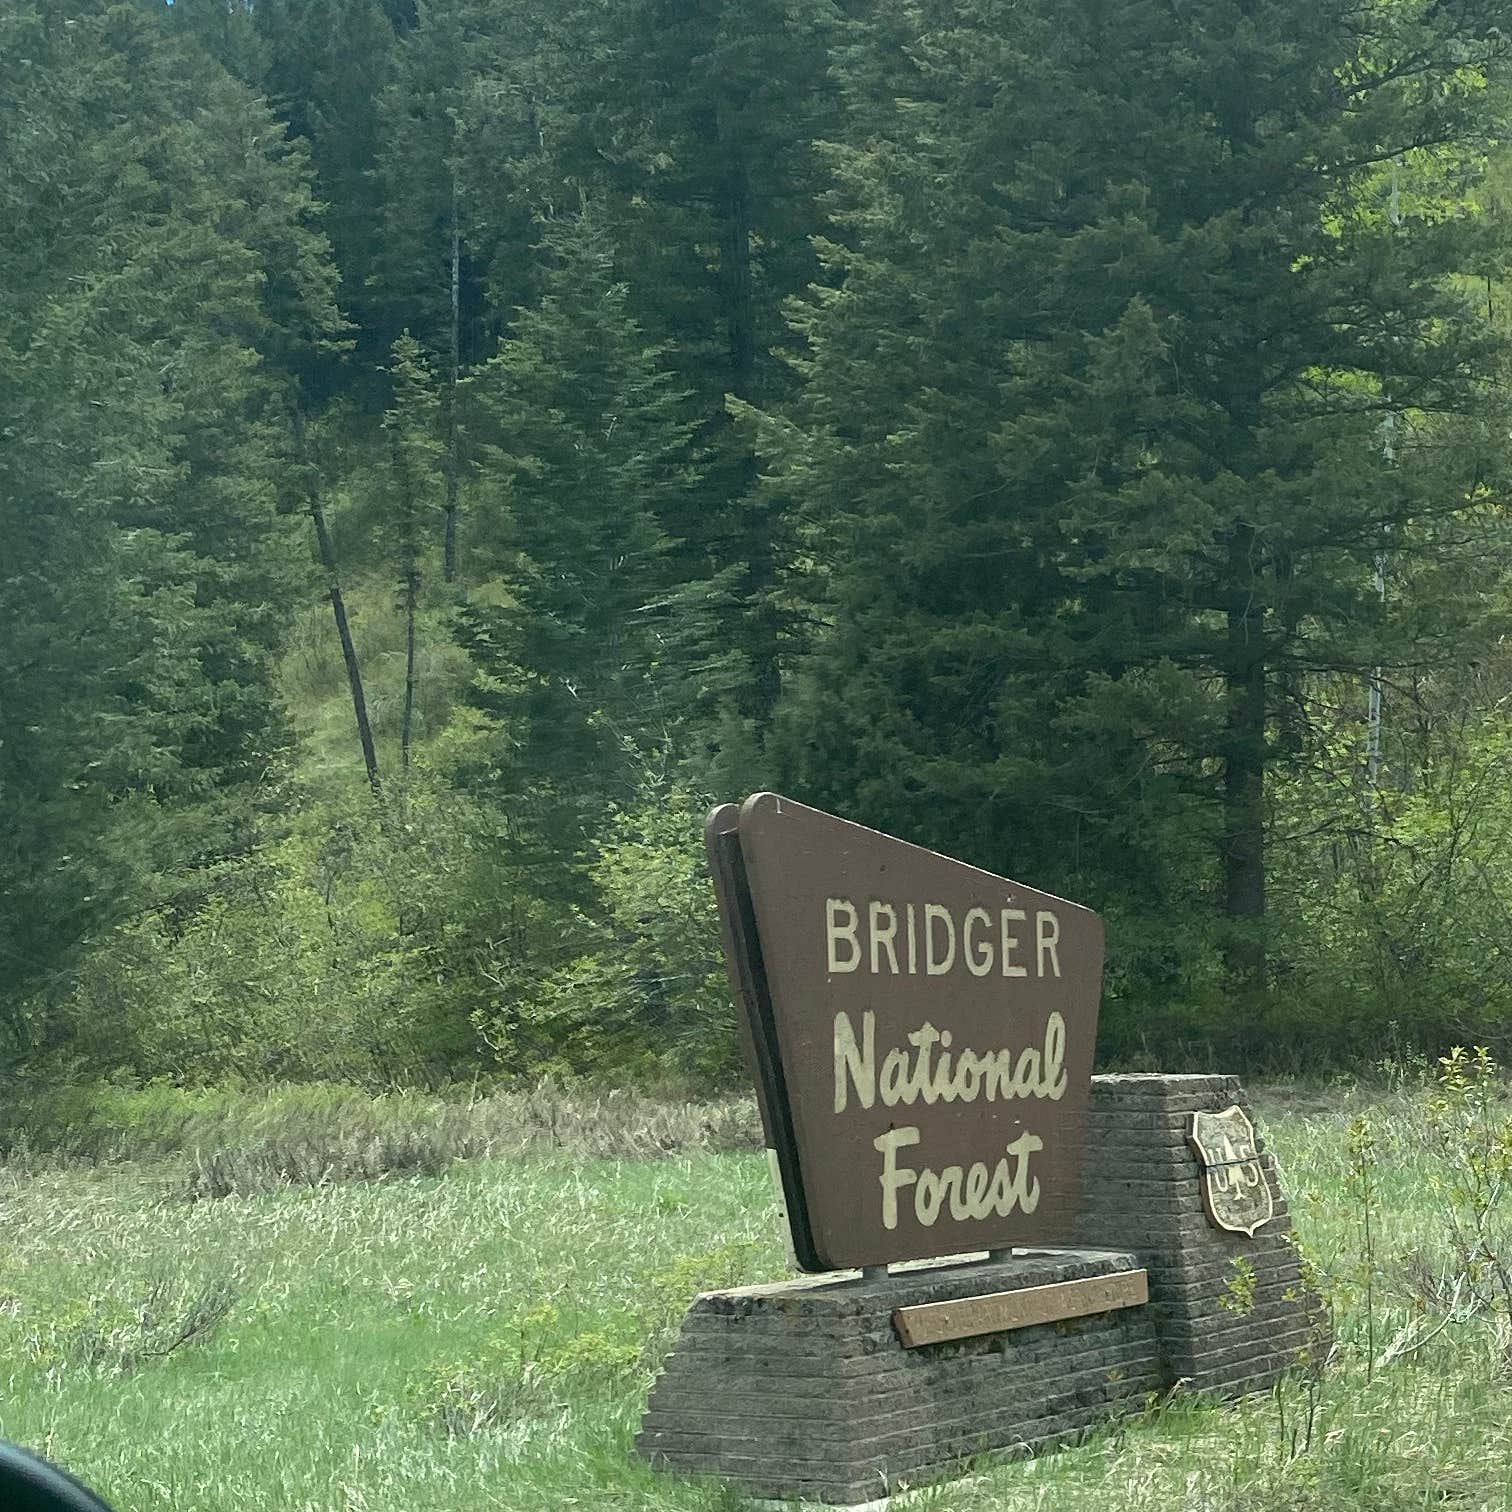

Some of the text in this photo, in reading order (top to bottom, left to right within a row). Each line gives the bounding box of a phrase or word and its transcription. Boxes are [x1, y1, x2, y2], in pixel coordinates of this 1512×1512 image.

[826, 898, 1061, 977] BRIDGER
[833, 1010, 1068, 1114] National
[873, 1126, 1044, 1230] Forest
